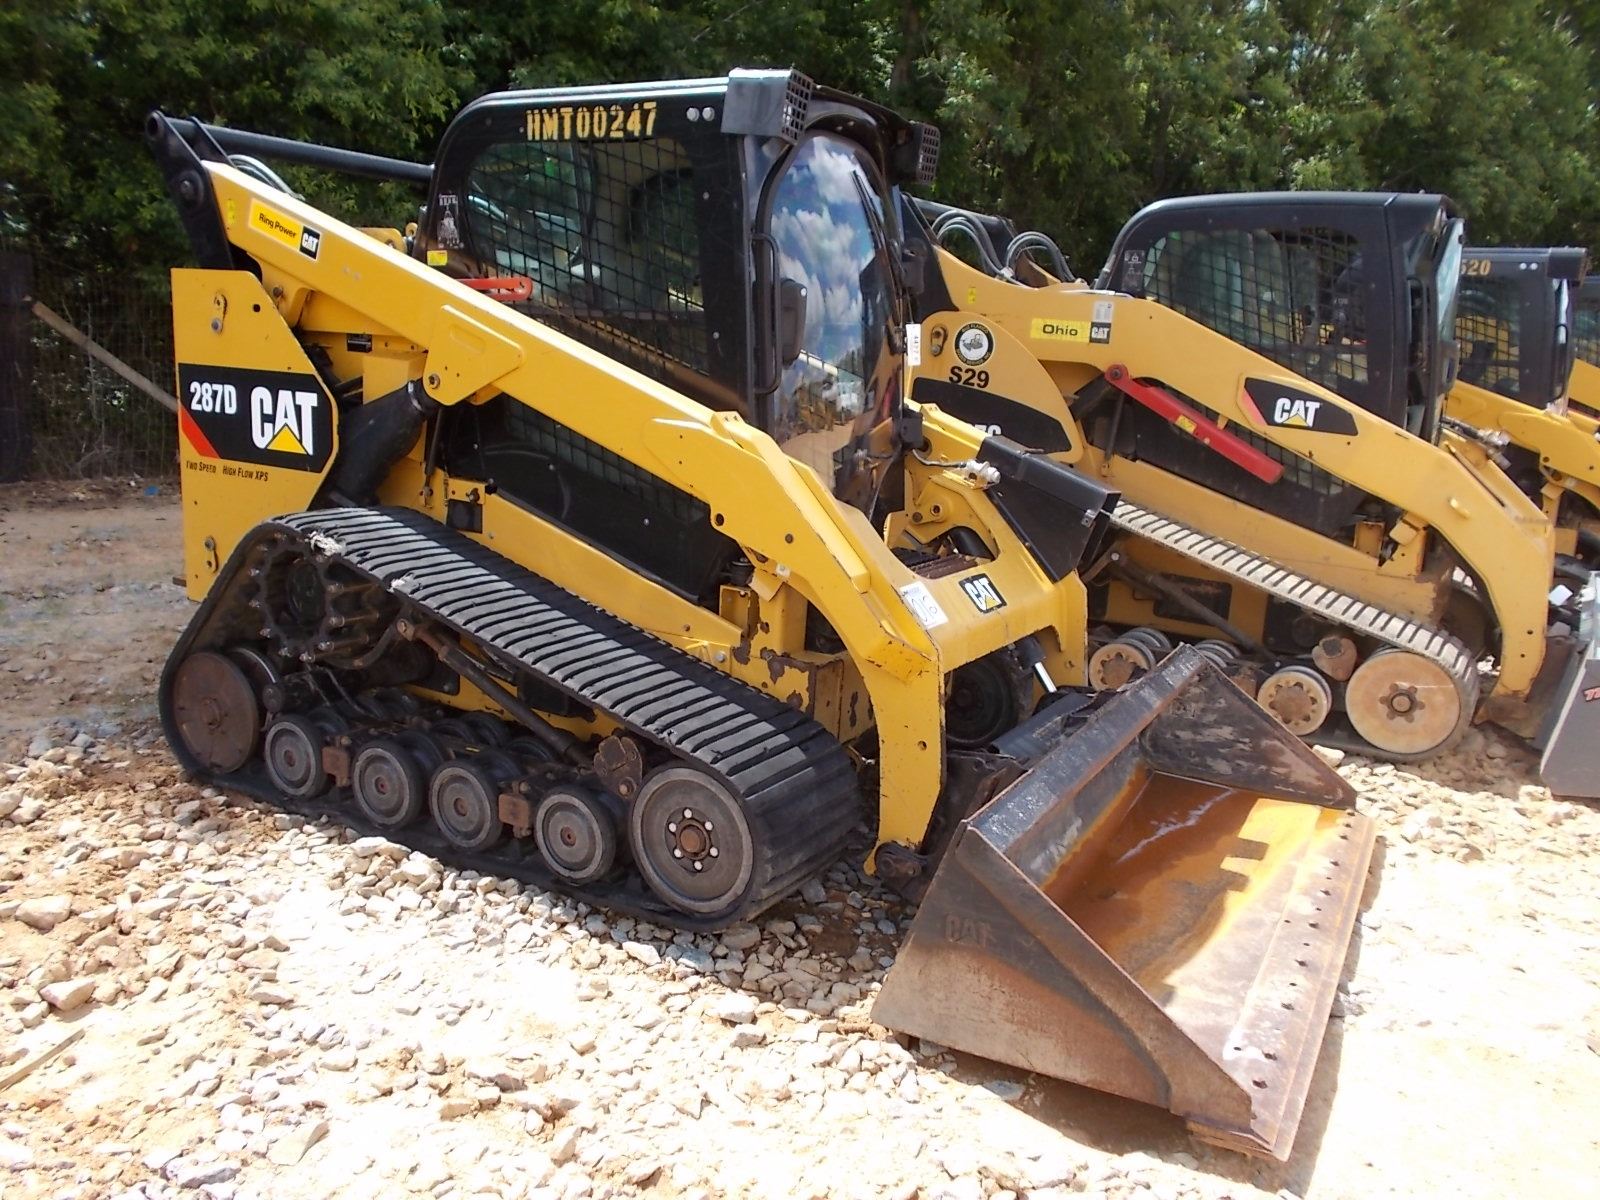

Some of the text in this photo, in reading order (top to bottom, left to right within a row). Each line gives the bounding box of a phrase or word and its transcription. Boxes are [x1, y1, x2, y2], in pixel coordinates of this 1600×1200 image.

[526, 101, 657, 141] HMT00247
[259, 213, 297, 238] Ring Power
[302, 232, 318, 252] CAT
[1043, 324, 1078, 336] Ohio
[1091, 327, 1109, 339] CAT
[949, 365, 990, 389] S29
[189, 381, 238, 415] 287D
[250, 386, 318, 456] CAT
[1274, 397, 1321, 428] CAT
[255, 470, 269, 482] XPS
[964, 577, 1003, 611] CAT
[944, 911, 992, 949] CAT
